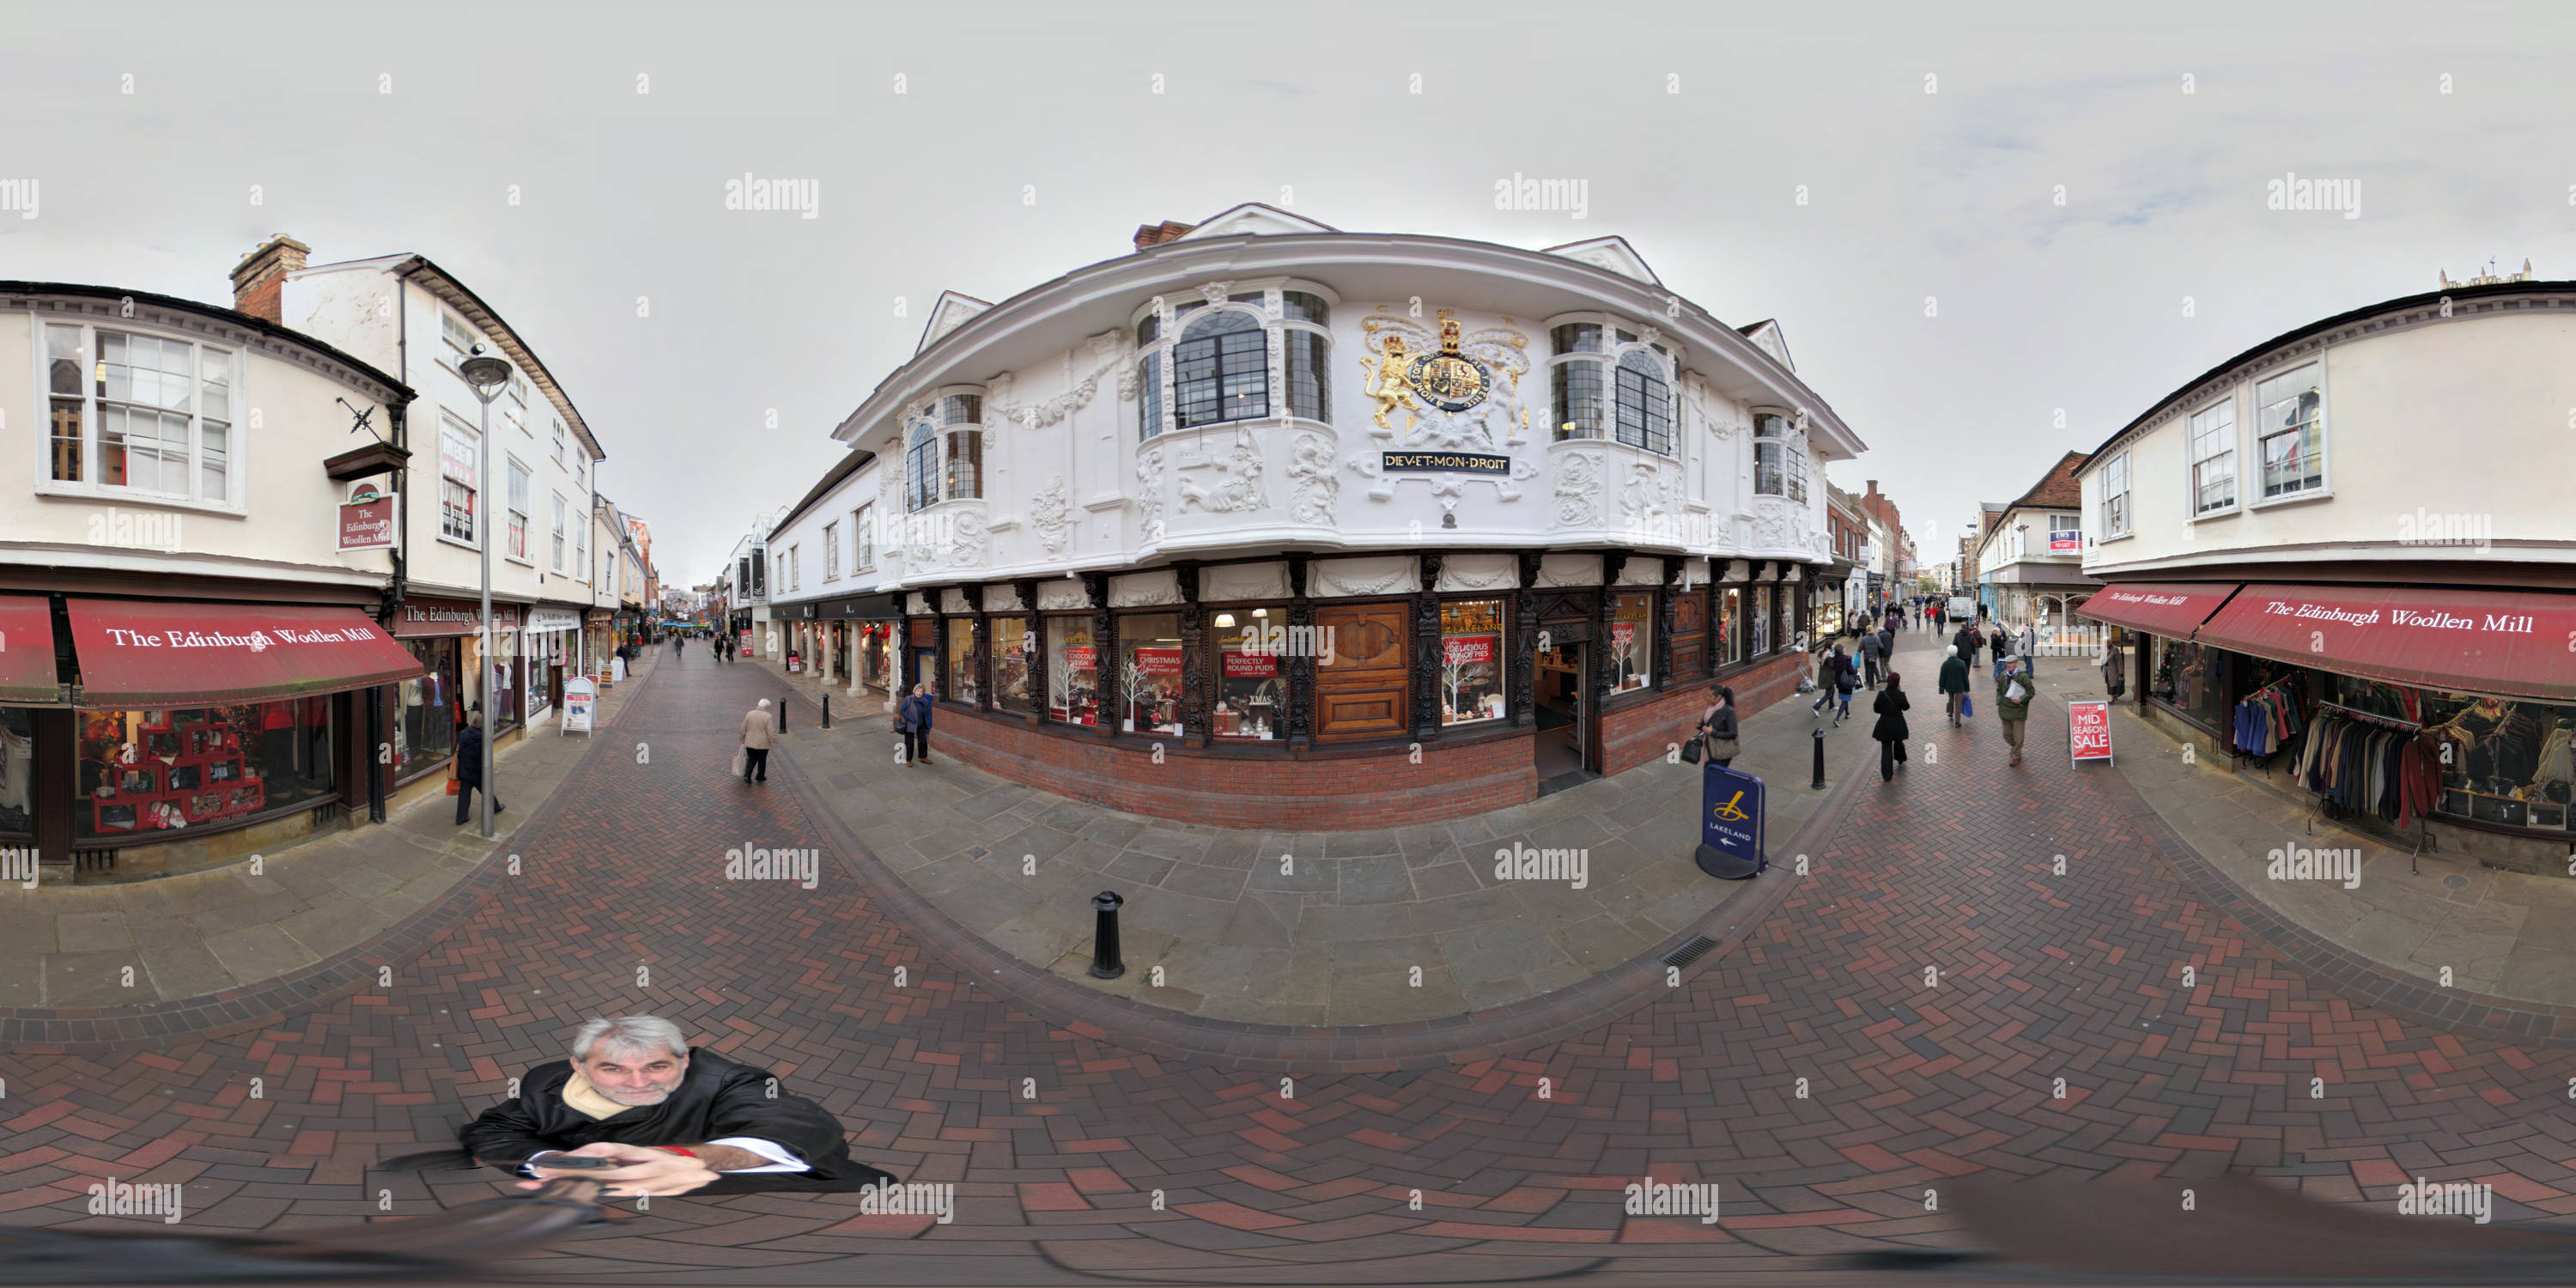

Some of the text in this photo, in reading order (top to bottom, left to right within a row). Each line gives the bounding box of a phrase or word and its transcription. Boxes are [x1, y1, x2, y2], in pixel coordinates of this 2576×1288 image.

[1465, 355, 1482, 369] MAL
[1411, 363, 1423, 379] SOIT
[1417, 383, 1435, 402] HONI
[1463, 386, 1490, 408] PENSE
[1469, 458, 1507, 469] DROIT
[358, 509, 373, 519] The
[346, 519, 385, 532] Edinburgh
[343, 532, 389, 545] Woollen Mill
[2118, 593, 2145, 604] Edinburgh
[2144, 594, 2168, 605] Woollen
[2167, 596, 2188, 605] Mill
[404, 605, 515, 625] The Edinburgh Wllen Mill
[2264, 601, 2533, 633] The Edinburgh Woollen Mill
[106, 628, 376, 650] The Edinburgh Woollen Mill
[1449, 643, 1488, 653] DELICIOUS
[2078, 714, 2100, 725] MID
[2073, 726, 2106, 734] SEASON
[2074, 734, 2108, 749] SALE
[1710, 822, 1751, 841] LAKELAND
